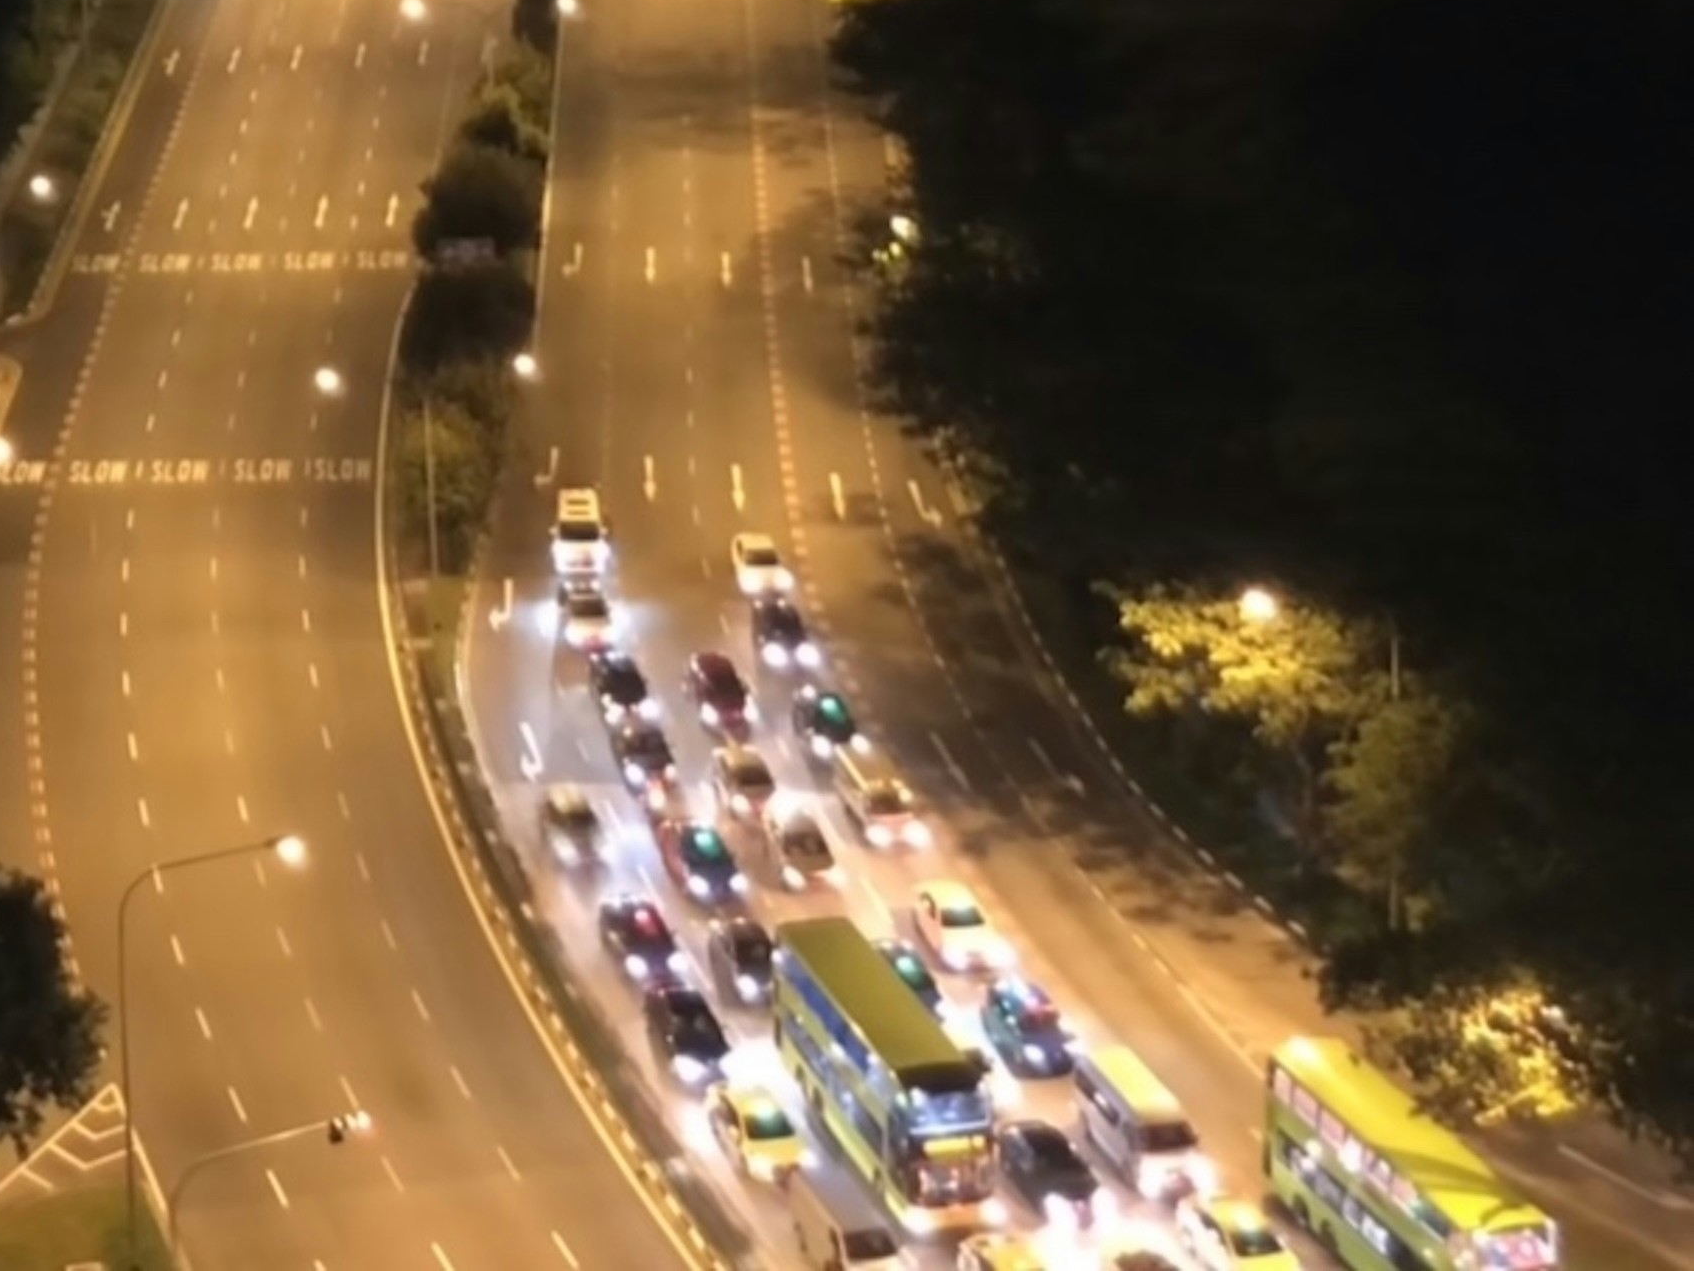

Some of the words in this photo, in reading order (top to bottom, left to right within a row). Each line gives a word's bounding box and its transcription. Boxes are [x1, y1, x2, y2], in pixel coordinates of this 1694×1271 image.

[139, 253, 191, 272] SLOW
[211, 253, 262, 271] SLOW
[284, 251, 335, 270] SLOW
[357, 251, 409, 269] SLOW
[68, 460, 128, 483] SLOW
[151, 459, 209, 483] SLOW
[234, 458, 293, 482] SLOW
[313, 457, 372, 481] SLOW
